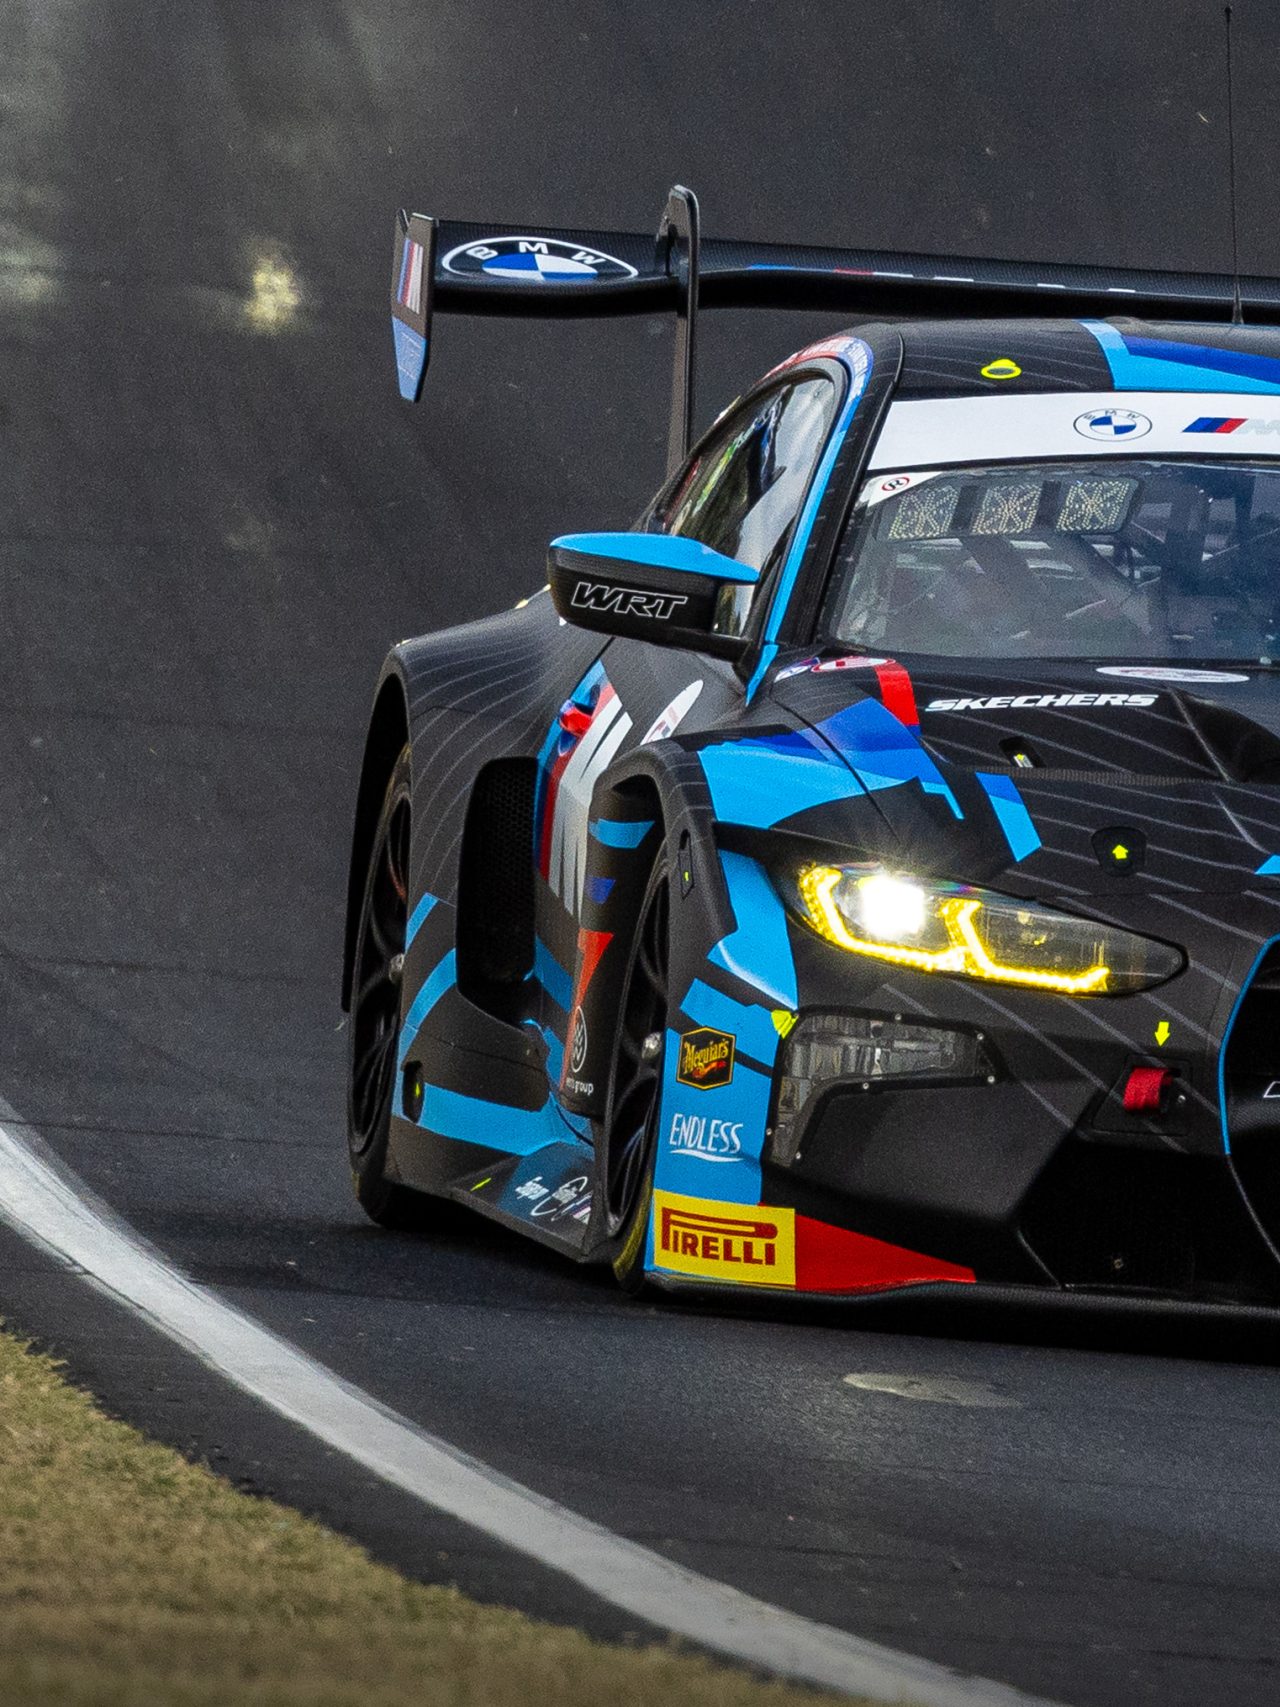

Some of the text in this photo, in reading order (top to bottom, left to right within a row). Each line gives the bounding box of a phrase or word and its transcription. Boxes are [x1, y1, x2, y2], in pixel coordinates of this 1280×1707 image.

[466, 241, 607, 265] BMW
[571, 581, 689, 619] WRT
[924, 693, 1159, 713] SKECHERS
[669, 1112, 744, 1154] ENDLESS
[661, 1206, 778, 1266] PIRELLI
